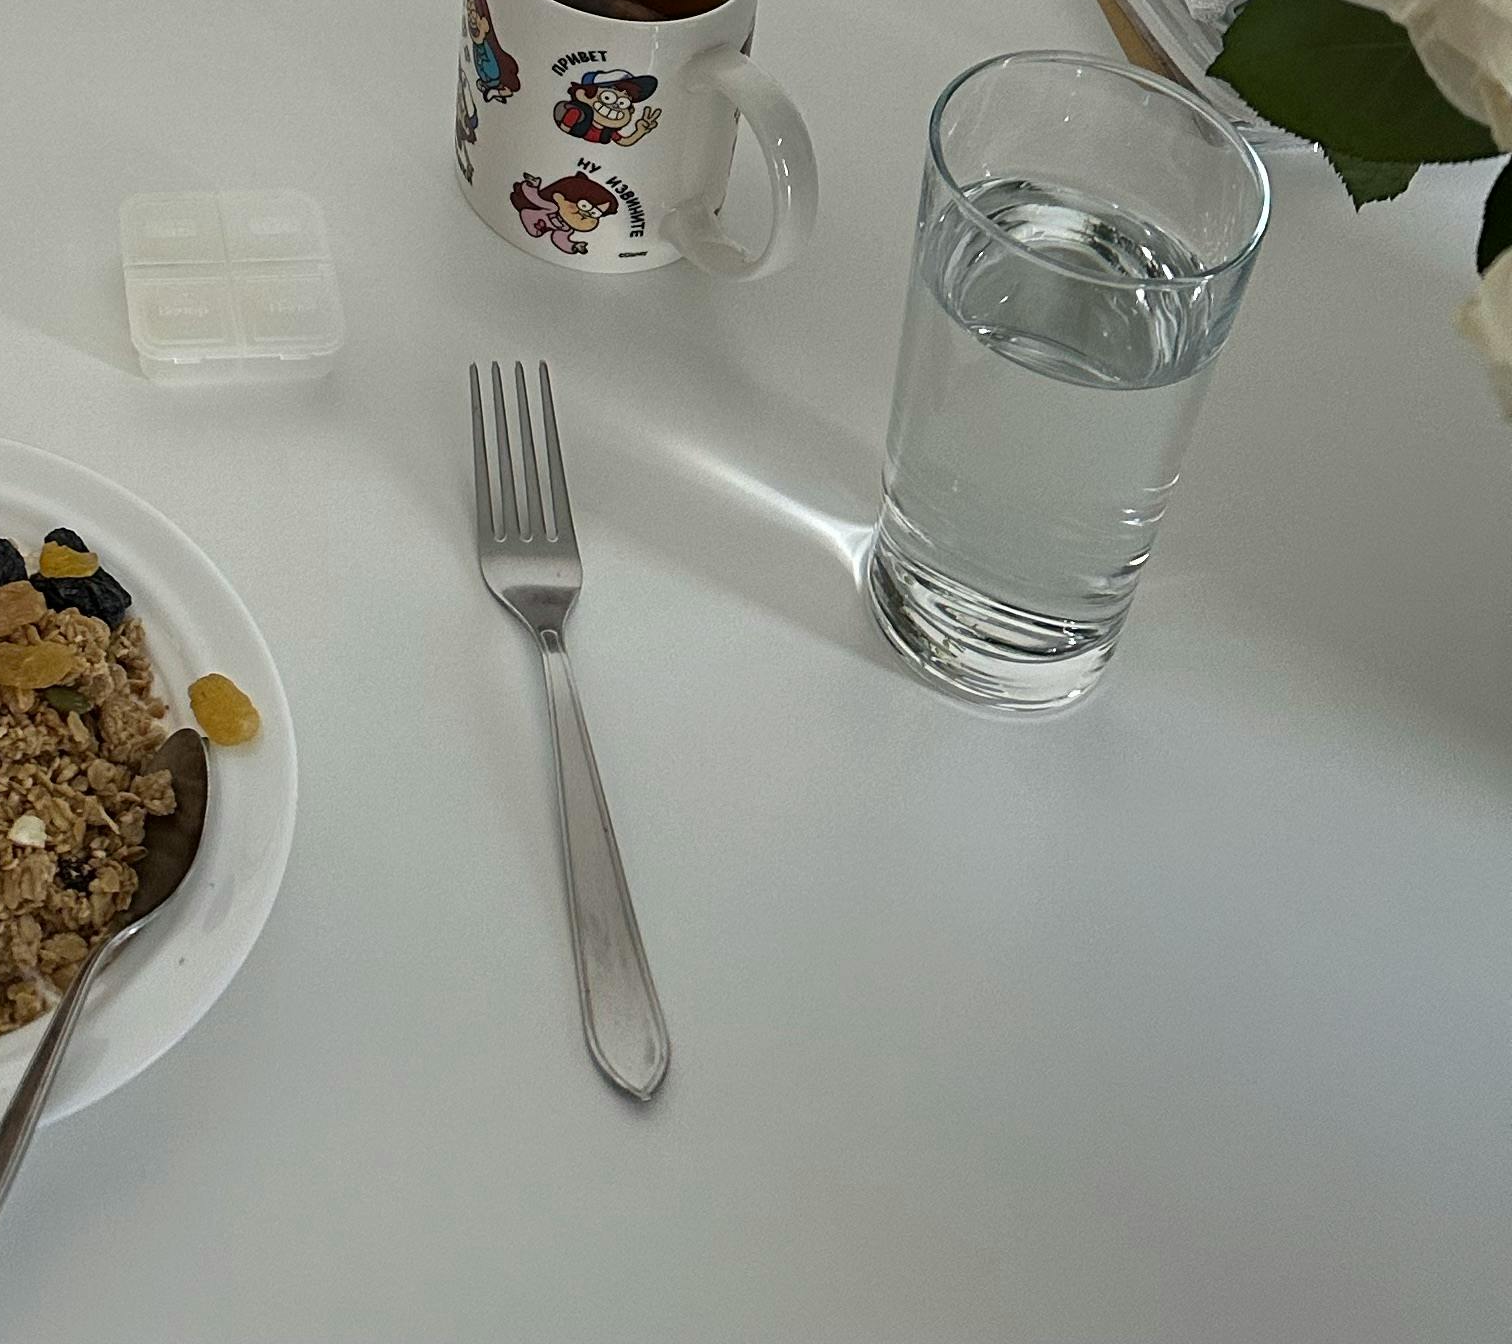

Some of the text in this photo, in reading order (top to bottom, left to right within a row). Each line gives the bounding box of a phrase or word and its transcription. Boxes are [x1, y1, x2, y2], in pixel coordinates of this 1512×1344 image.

[551, 50, 608, 77] ПРИВЕТ
[577, 157, 602, 174] НУ
[605, 176, 646, 238] ИЗВИНИТЕ
